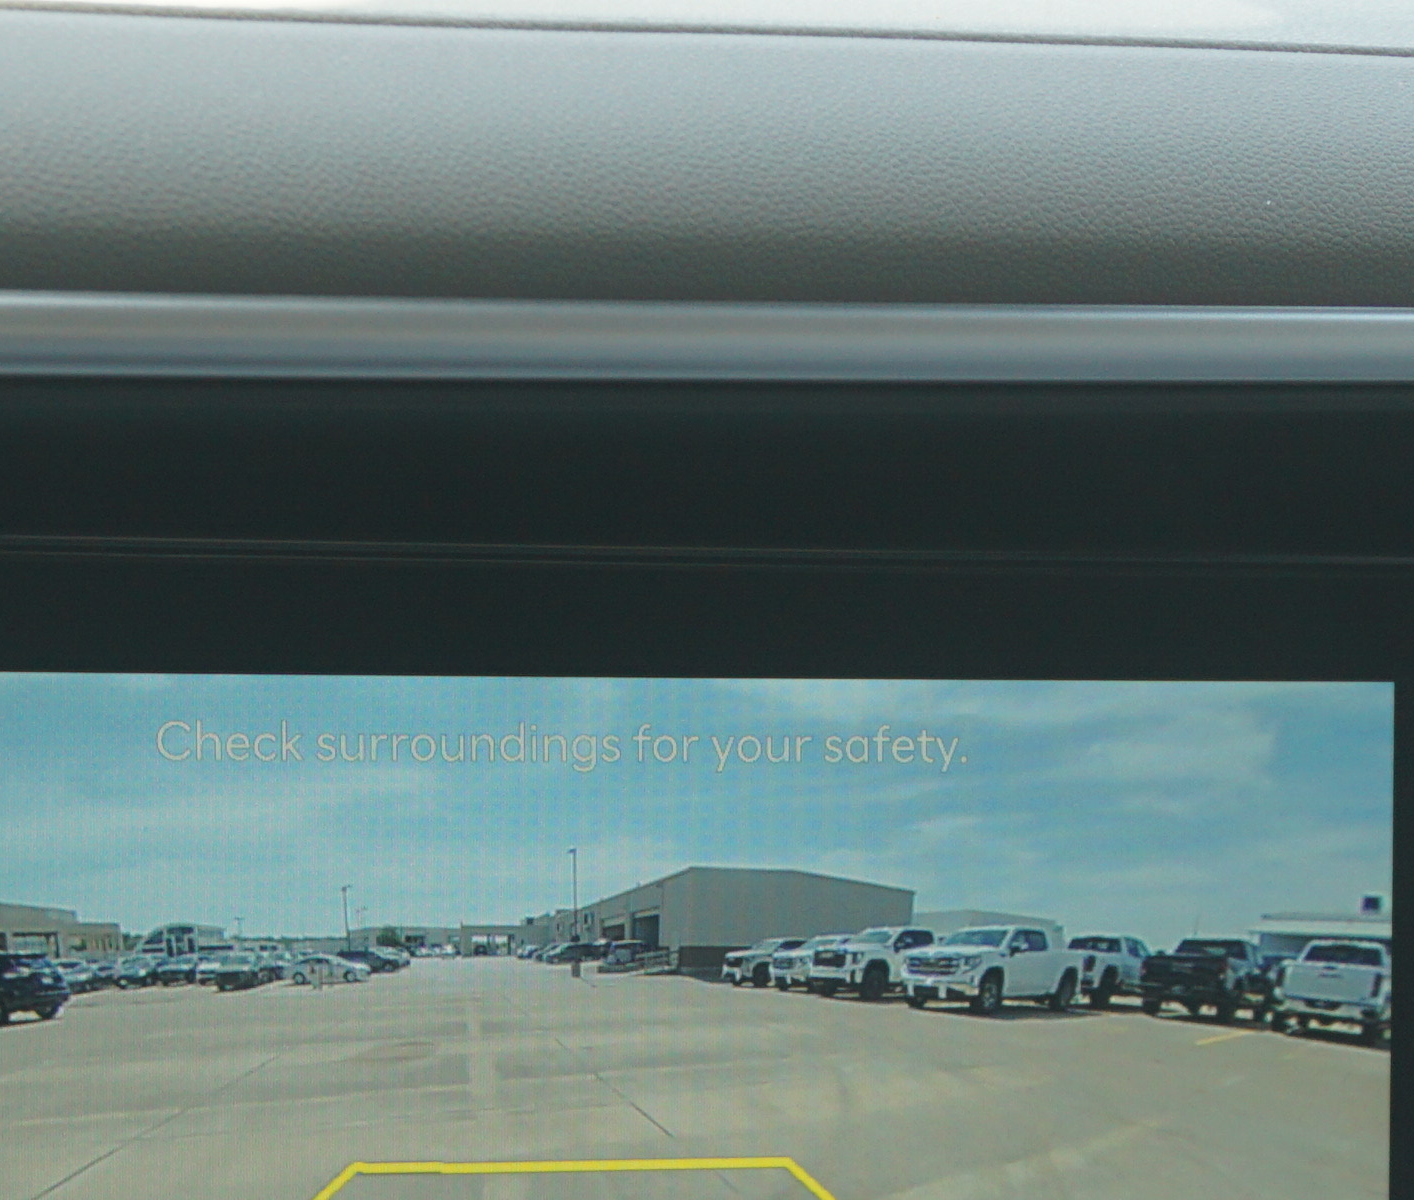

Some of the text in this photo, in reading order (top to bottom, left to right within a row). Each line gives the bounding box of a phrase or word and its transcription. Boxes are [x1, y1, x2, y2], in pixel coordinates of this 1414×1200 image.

[155, 719, 969, 774] Check surroundings for your safety.
